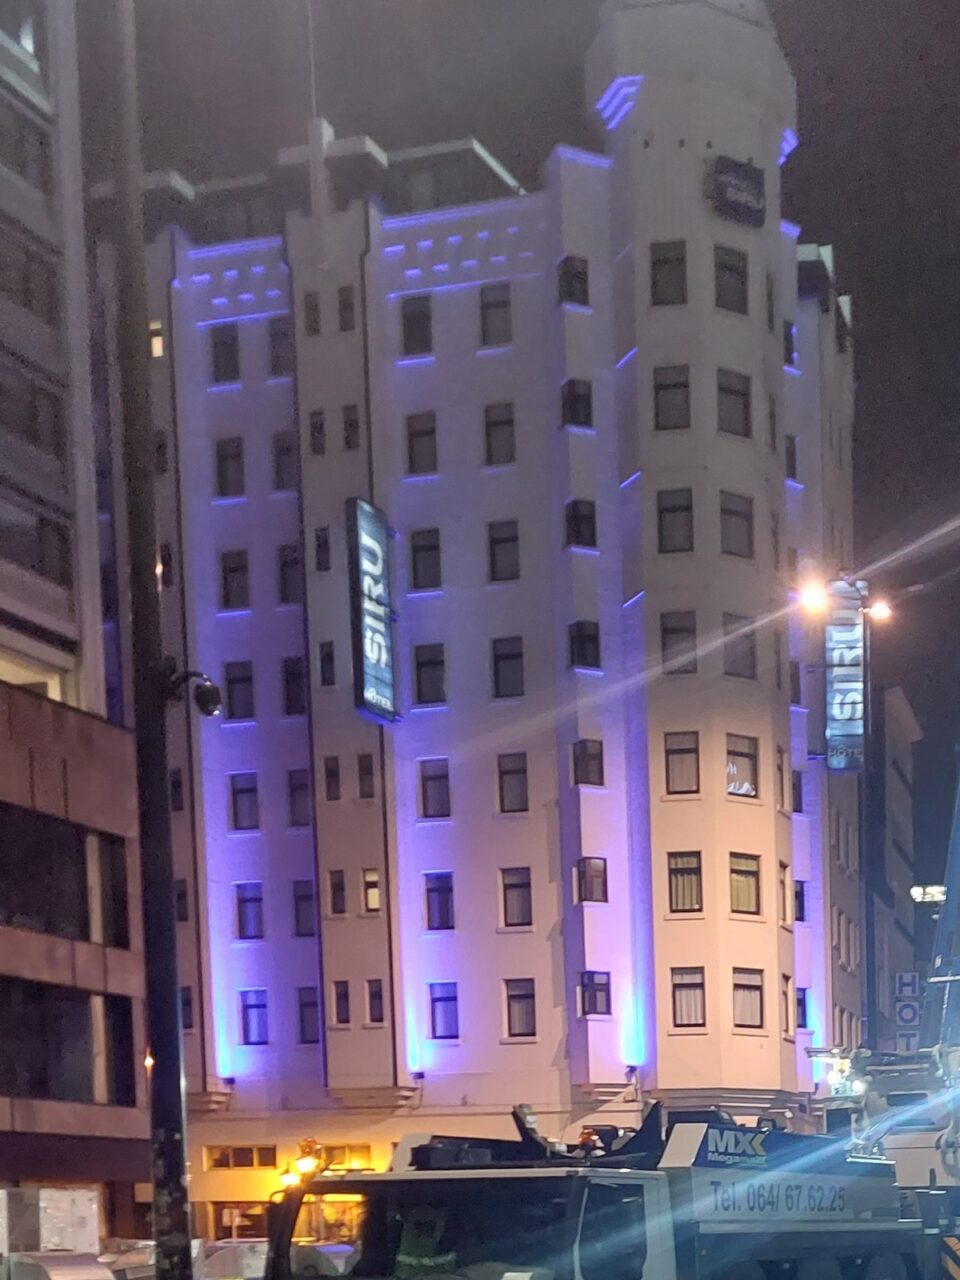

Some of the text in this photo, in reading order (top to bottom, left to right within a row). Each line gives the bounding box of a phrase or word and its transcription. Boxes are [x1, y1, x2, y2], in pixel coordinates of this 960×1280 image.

[361, 532, 388, 669] SIRU
[710, 1181, 846, 1213] Tel. 064/ 67.62.25
